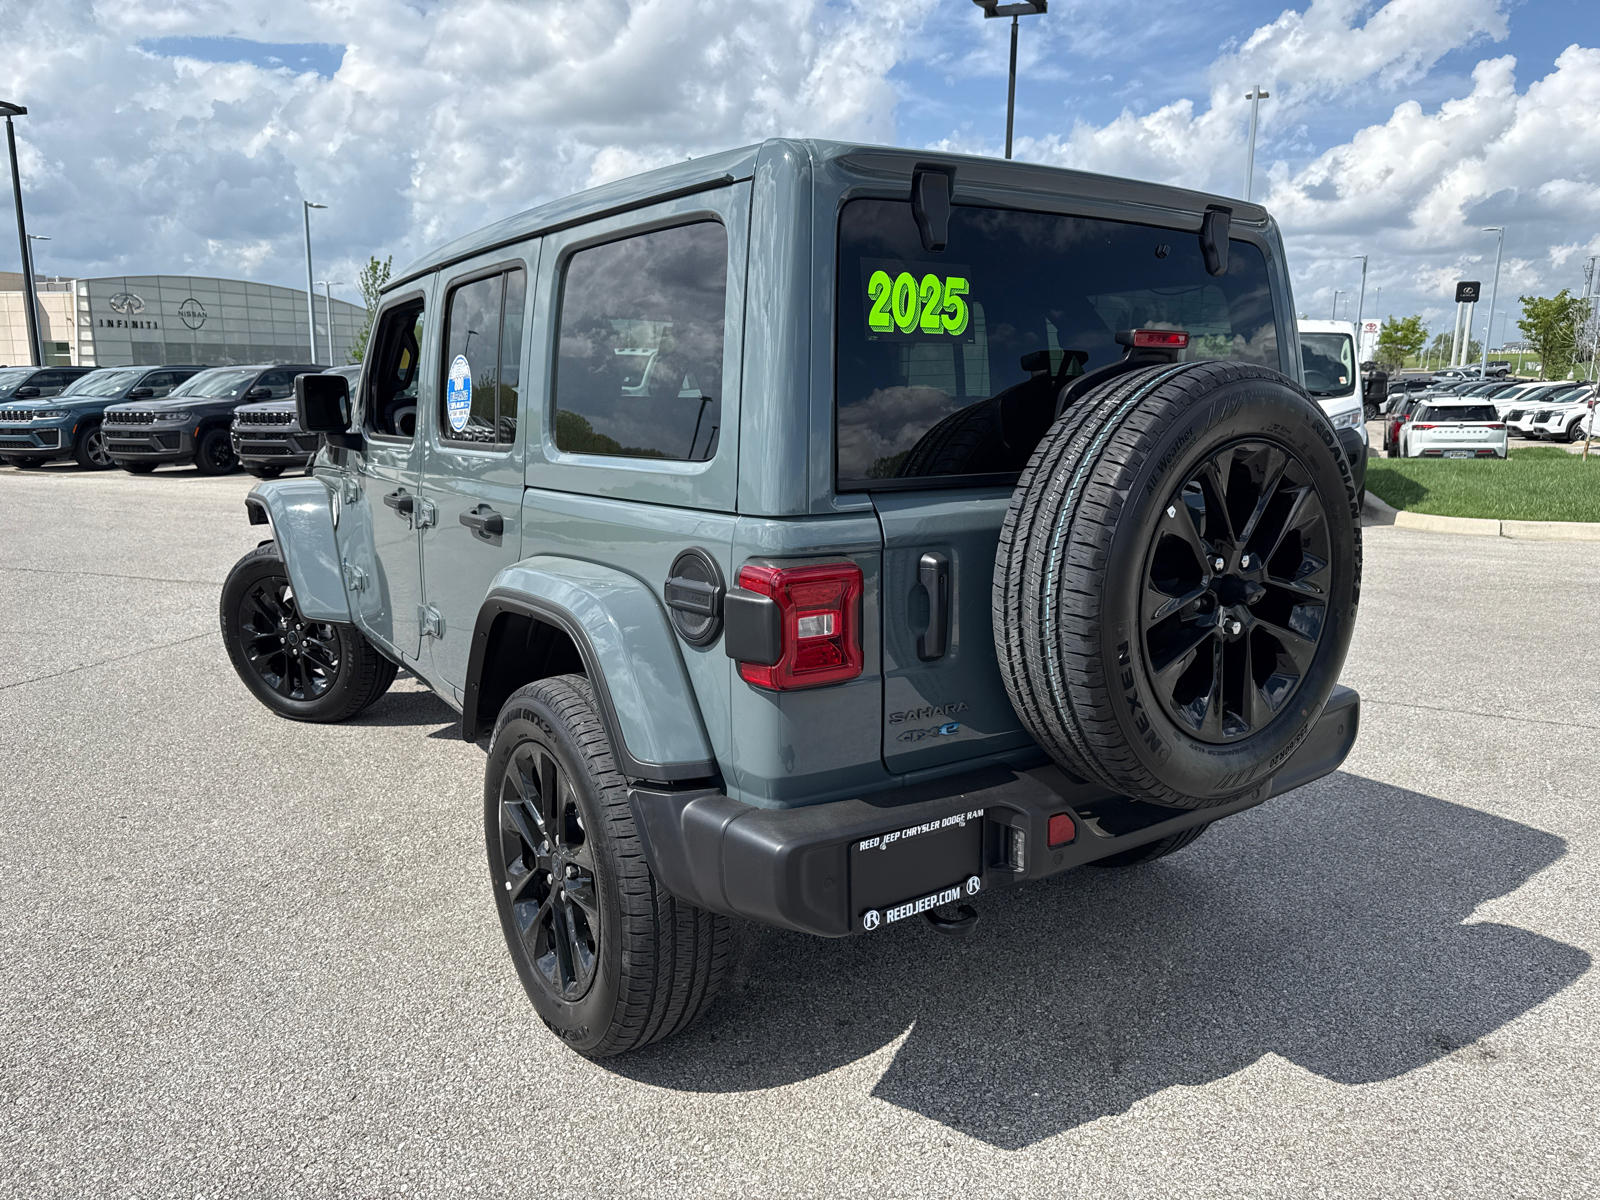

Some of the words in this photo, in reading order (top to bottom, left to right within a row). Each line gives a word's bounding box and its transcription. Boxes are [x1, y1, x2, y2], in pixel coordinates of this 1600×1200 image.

[99, 318, 158, 330] INFINITI
[177, 310, 208, 319] NISSAN
[868, 270, 970, 336] 2025
[1146, 426, 1194, 496] All-Weather
[1311, 418, 1360, 520] ROADIAN
[888, 701, 970, 725] SAHARA
[1117, 640, 1163, 754] NEXEN
[859, 837, 880, 852] REED
[882, 831, 901, 846] JEEP
[901, 820, 941, 839] CHRYSLER
[941, 812, 966, 828] DODGE
[966, 808, 984, 821] RAM
[886, 886, 961, 924] REEDJEEP.COM
